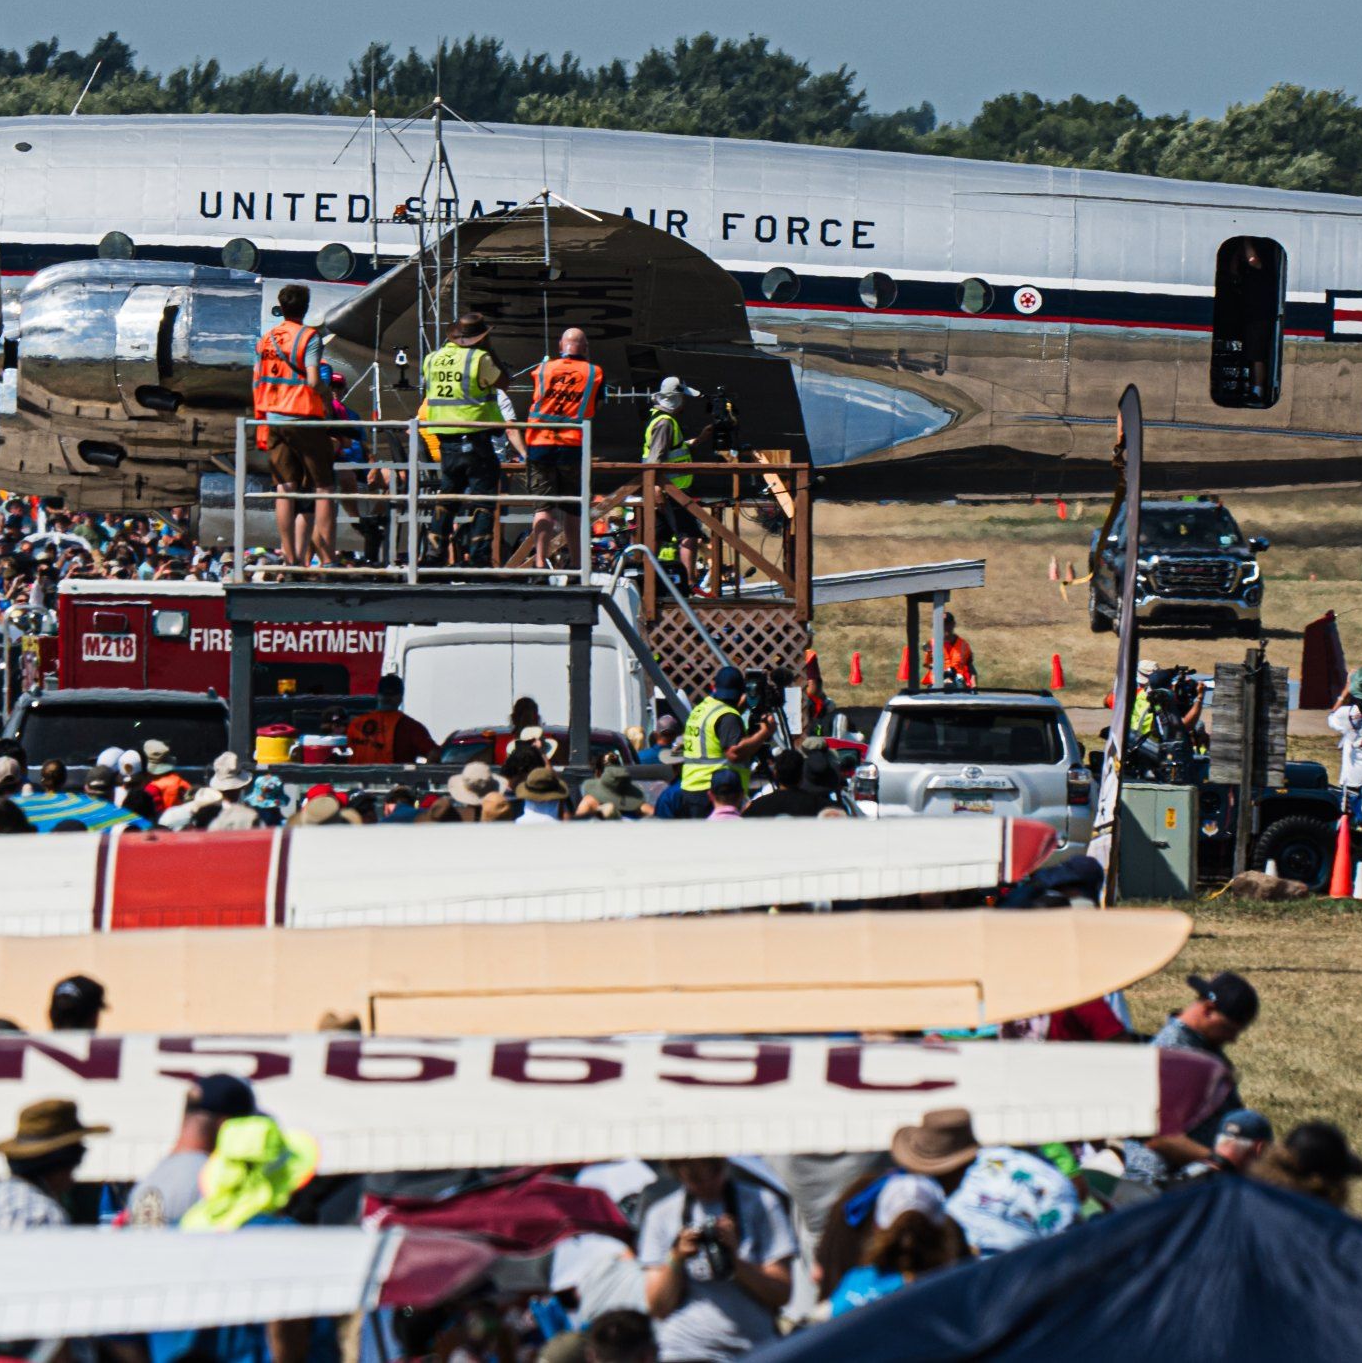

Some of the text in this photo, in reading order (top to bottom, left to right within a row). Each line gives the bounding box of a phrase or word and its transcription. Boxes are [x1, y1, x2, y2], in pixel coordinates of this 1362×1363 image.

[199, 190, 370, 224] UNITED
[404, 196, 545, 226] STAT
[722, 212, 876, 249] FORCE
[432, 371, 462, 383] DEO
[436, 384, 454, 397] 22
[83, 634, 135, 659] M218
[189, 628, 233, 652] FIRE
